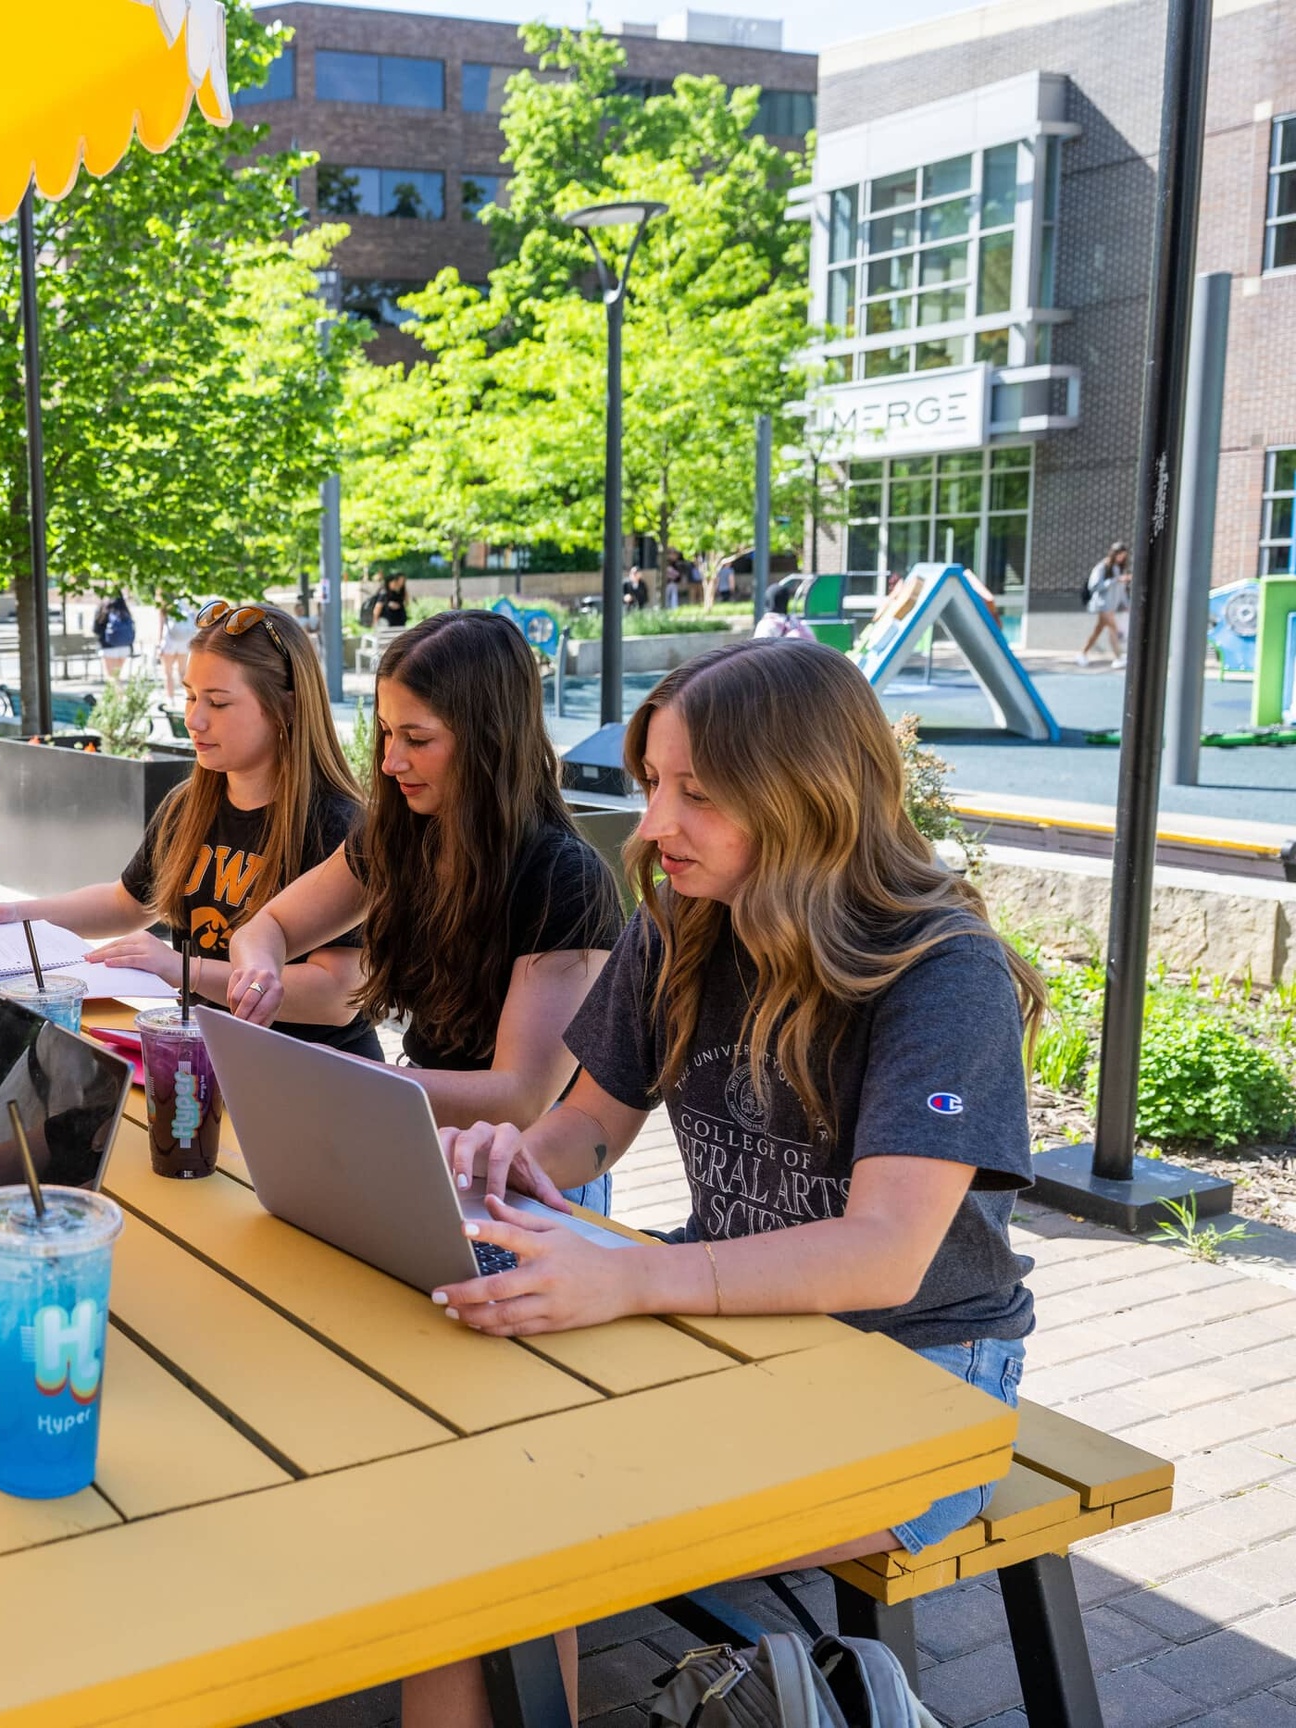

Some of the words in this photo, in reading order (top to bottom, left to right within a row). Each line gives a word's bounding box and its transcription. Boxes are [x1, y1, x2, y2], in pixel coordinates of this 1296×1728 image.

[832, 391, 967, 440] MERGE
[693, 1044, 780, 1070] UNIVERTY
[172, 1071, 201, 1139] Hyper
[675, 1126, 770, 1204] BERAL
[681, 1113, 776, 1160] COLLEGE
[784, 1149, 812, 1170] OF
[37, 1408, 91, 1435] Hyper
